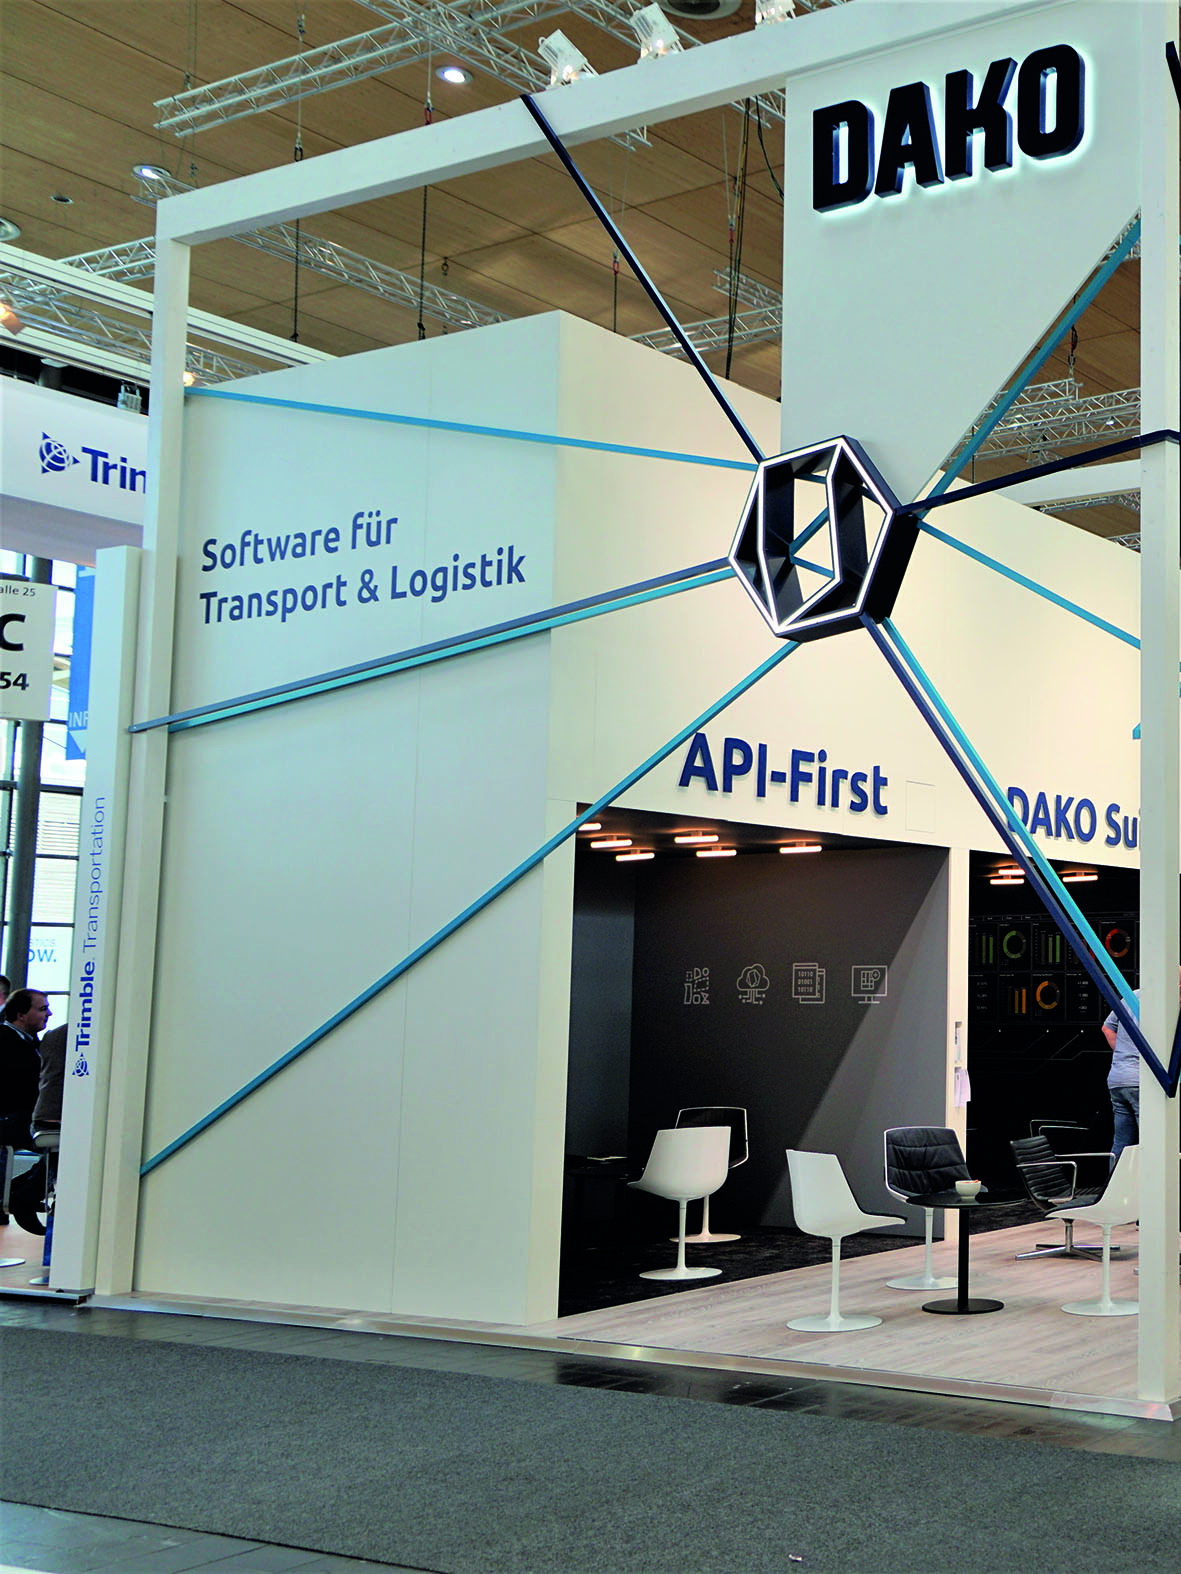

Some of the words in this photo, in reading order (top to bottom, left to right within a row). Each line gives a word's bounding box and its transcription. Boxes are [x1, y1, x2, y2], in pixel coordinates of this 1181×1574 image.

[813, 44, 1085, 213] DAKO
[201, 526, 340, 572] Software
[351, 510, 398, 549] für
[22, 587, 36, 597] 25
[200, 574, 347, 624] Transport
[357, 569, 379, 604] &
[391, 545, 526, 603] Logistik
[0, 613, 26, 651] C
[0, 671, 29, 691] 54
[678, 732, 888, 815] API-First
[1007, 787, 1096, 842] DAKO
[83, 796, 104, 953] Transportation
[76, 960, 95, 1052] Trimble
